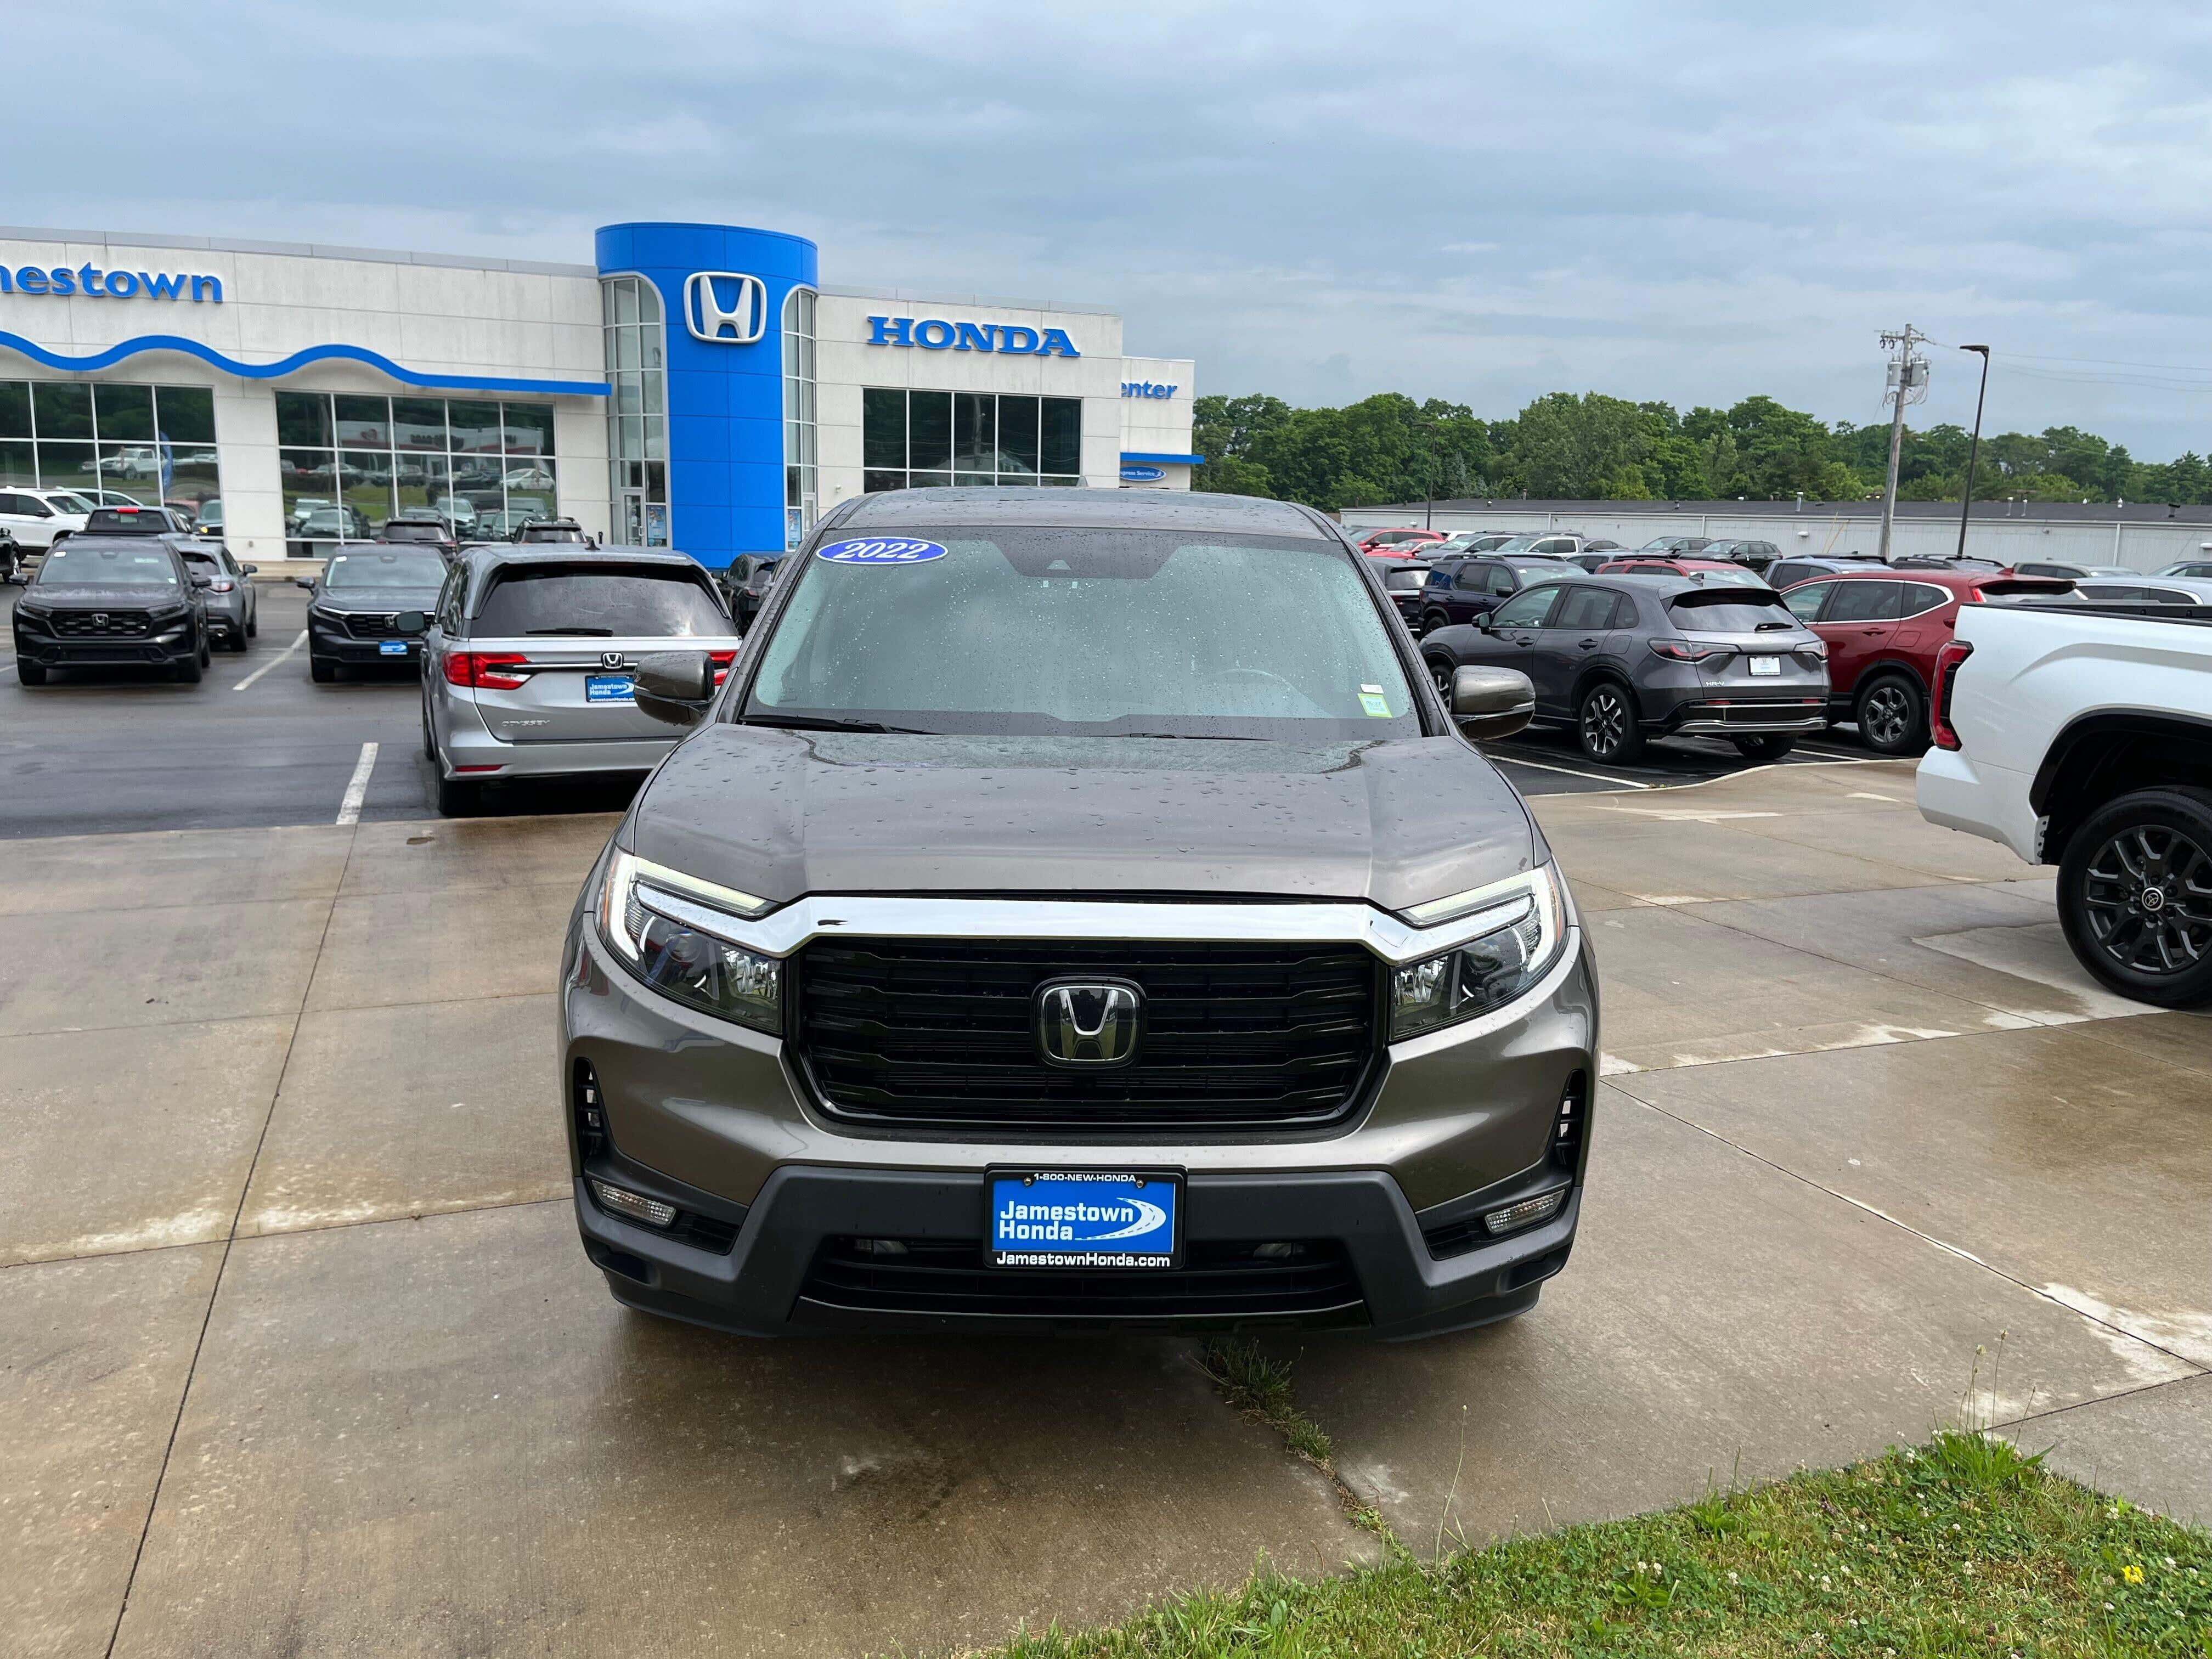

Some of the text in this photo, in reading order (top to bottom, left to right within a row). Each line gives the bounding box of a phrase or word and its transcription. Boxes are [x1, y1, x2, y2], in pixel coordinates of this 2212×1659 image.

[867, 316, 1081, 357] HONDA
[833, 542, 929, 559] 2022
[1034, 1173, 1136, 1182] 1-800-NEW-HONDA
[1000, 1200, 1133, 1222] Jamestown
[999, 1220, 1073, 1240] Honda
[996, 1251, 1170, 1267] JamestownHonda.com
